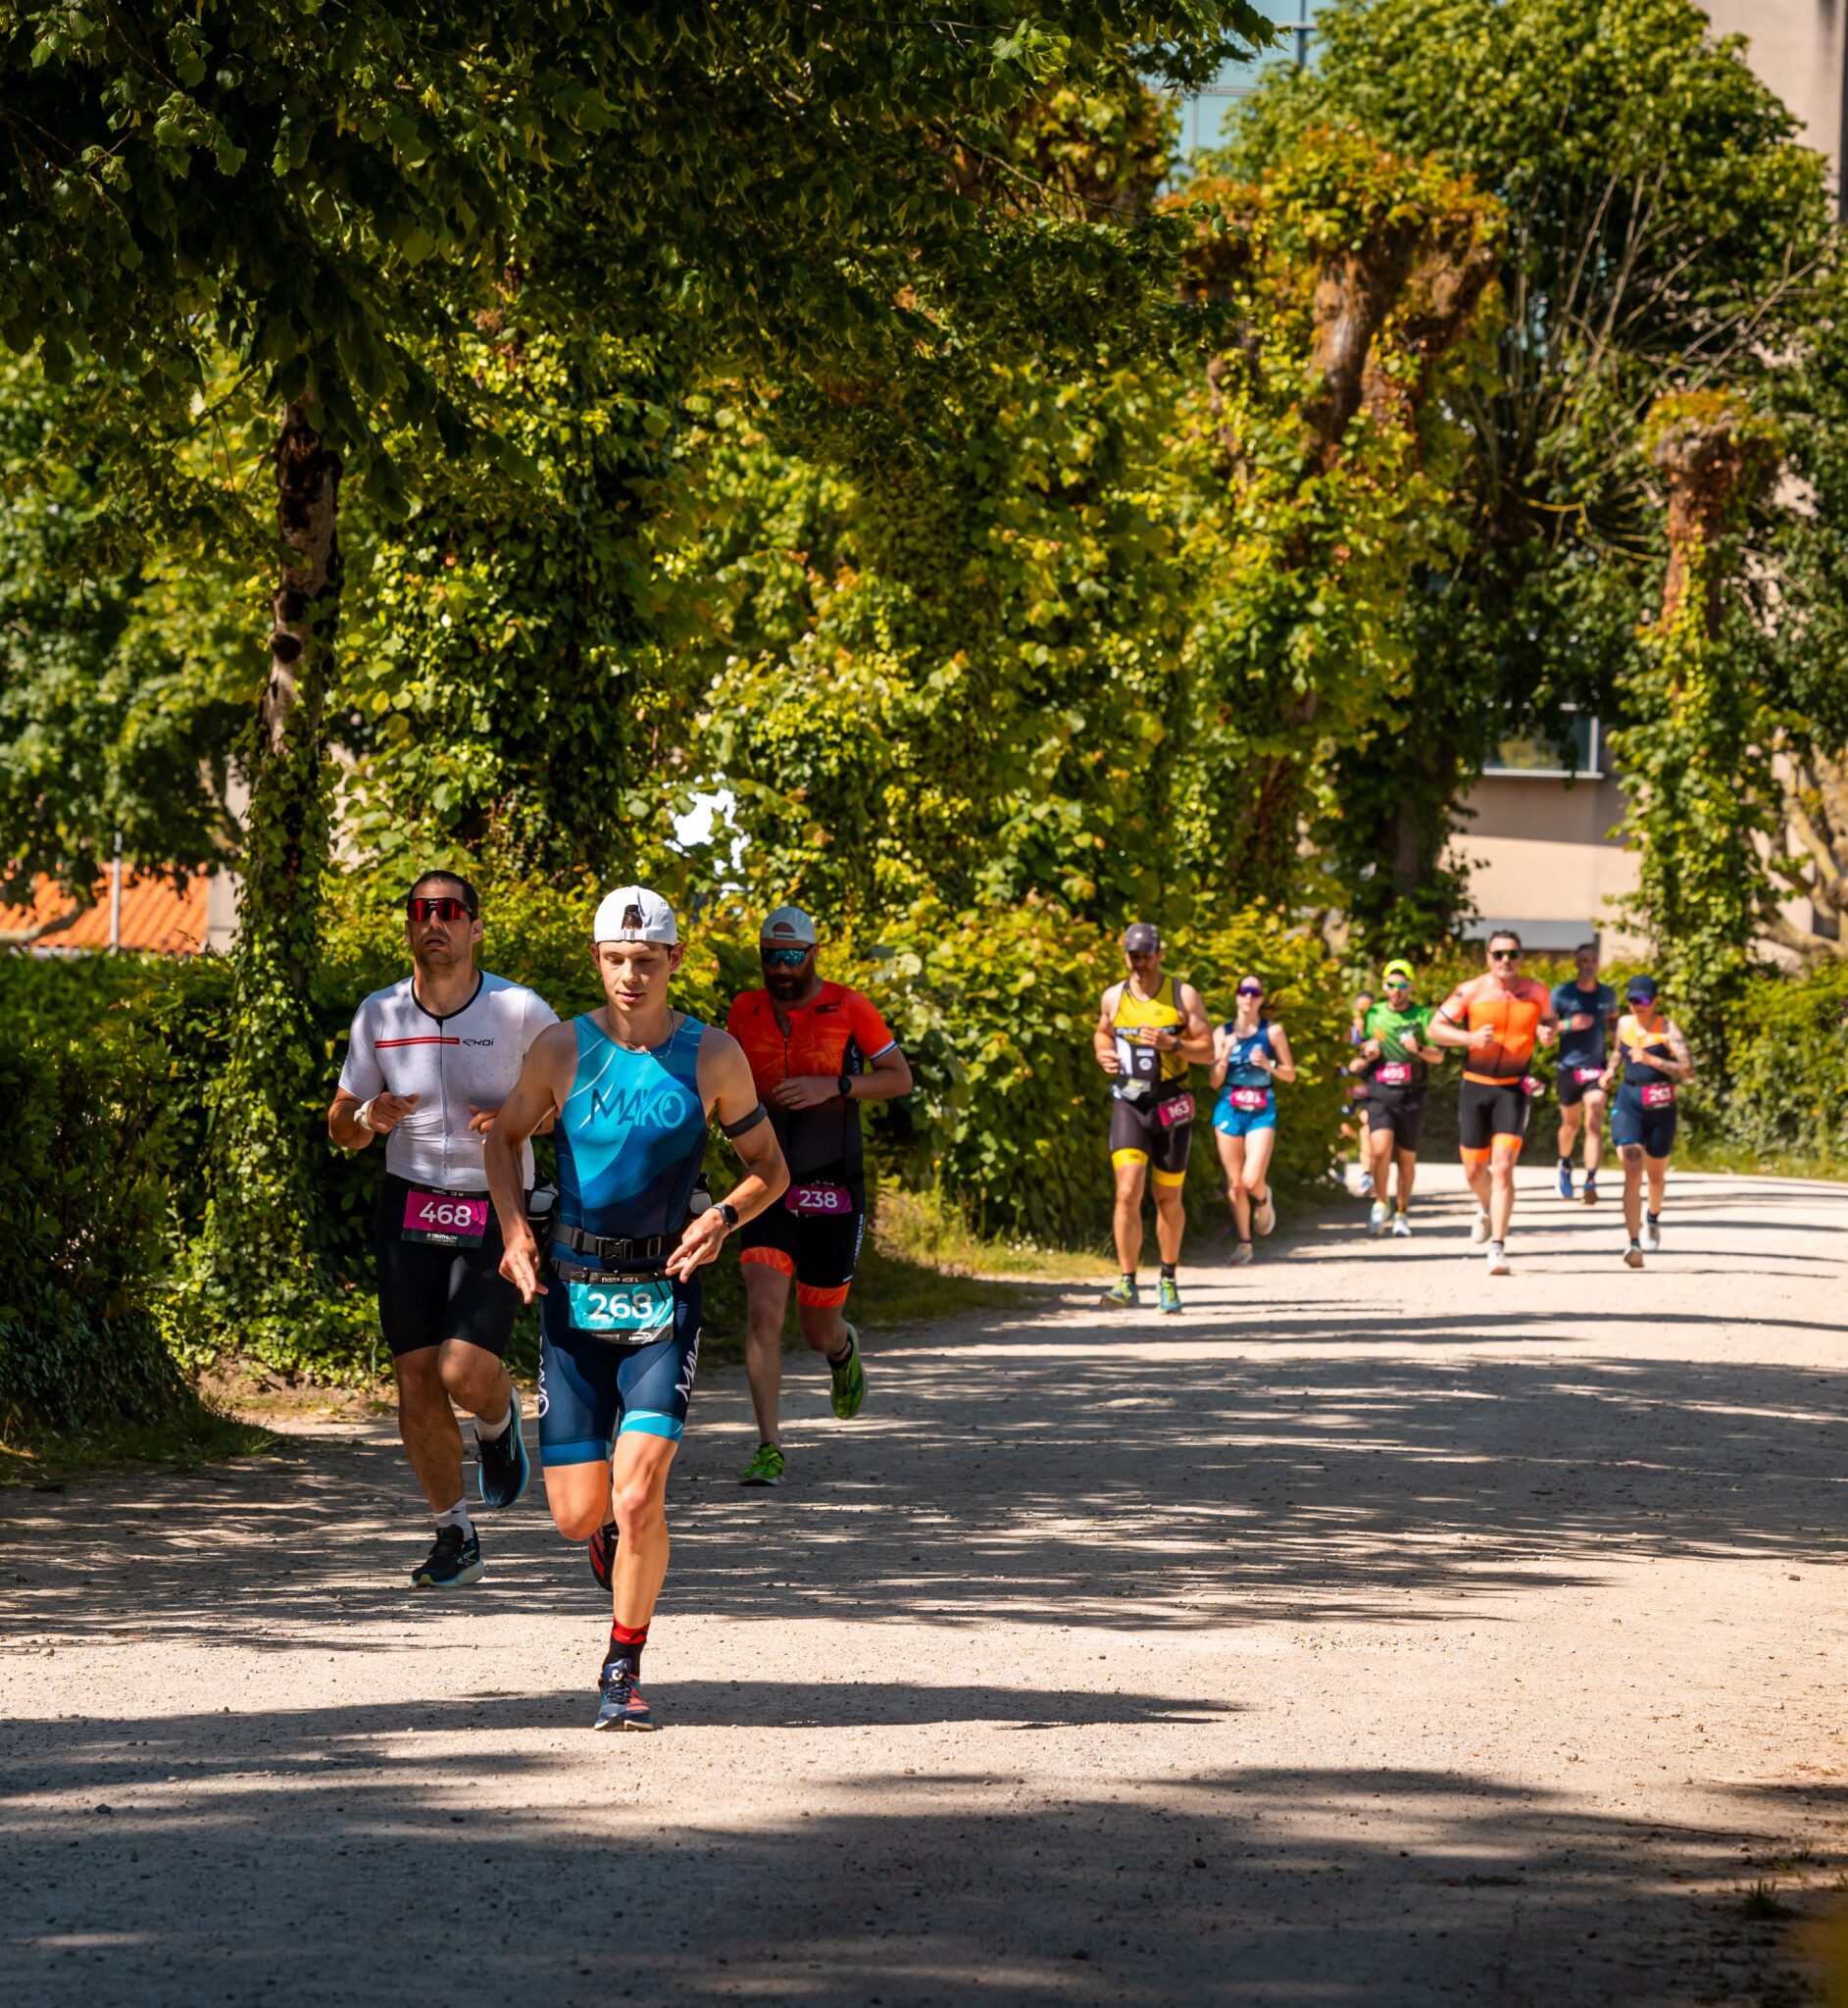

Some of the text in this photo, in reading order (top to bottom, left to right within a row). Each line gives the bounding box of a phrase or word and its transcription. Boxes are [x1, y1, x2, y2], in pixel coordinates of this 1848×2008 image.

[590, 1088, 685, 1129] MAKO
[1167, 1100, 1190, 1119] 163
[798, 1189, 838, 1208] 238
[419, 1201, 472, 1227] 468
[588, 1292, 654, 1320] 268
